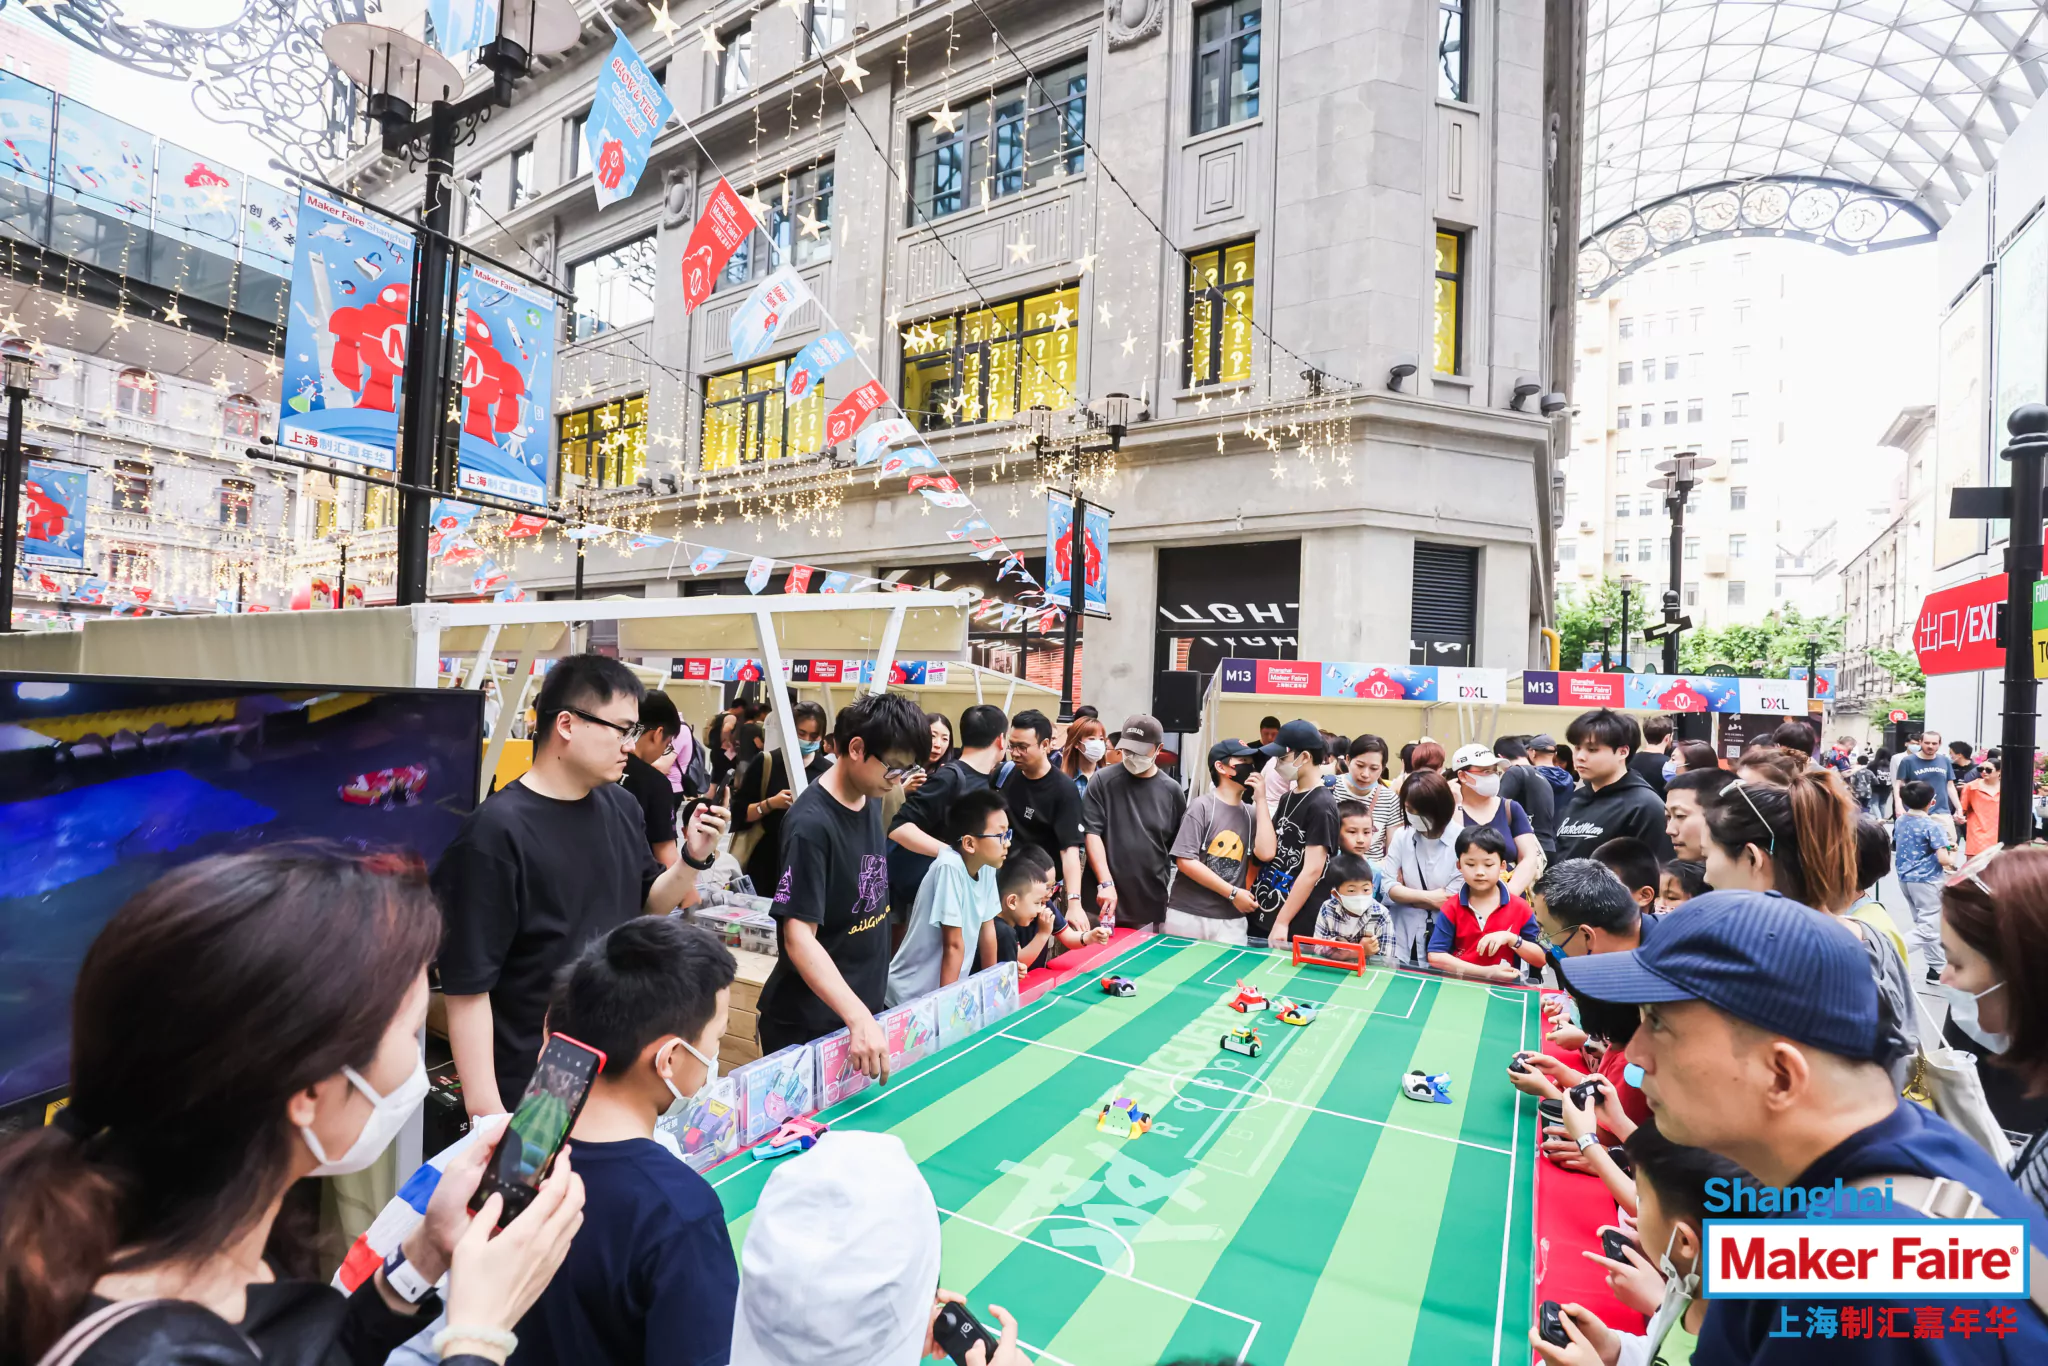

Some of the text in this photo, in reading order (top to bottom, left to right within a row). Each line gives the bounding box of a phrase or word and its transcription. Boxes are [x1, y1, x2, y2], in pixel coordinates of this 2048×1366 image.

[638, 96, 658, 129] TELL
[307, 195, 409, 247] Maker Faire Shanghai
[712, 204, 739, 241] Maker Faire
[474, 269, 499, 285] Maker
[500, 280, 519, 294] Faire
[764, 292, 779, 309] Faire
[771, 285, 788, 303] Maker
[289, 431, 387, 464] 上海制汇嘉年华
[1919, 600, 2007, 654] 出口/EXI
[672, 664, 684, 673] M10
[794, 664, 808, 673] M10
[1226, 669, 1252, 682] M13
[1528, 681, 1554, 694] M13
